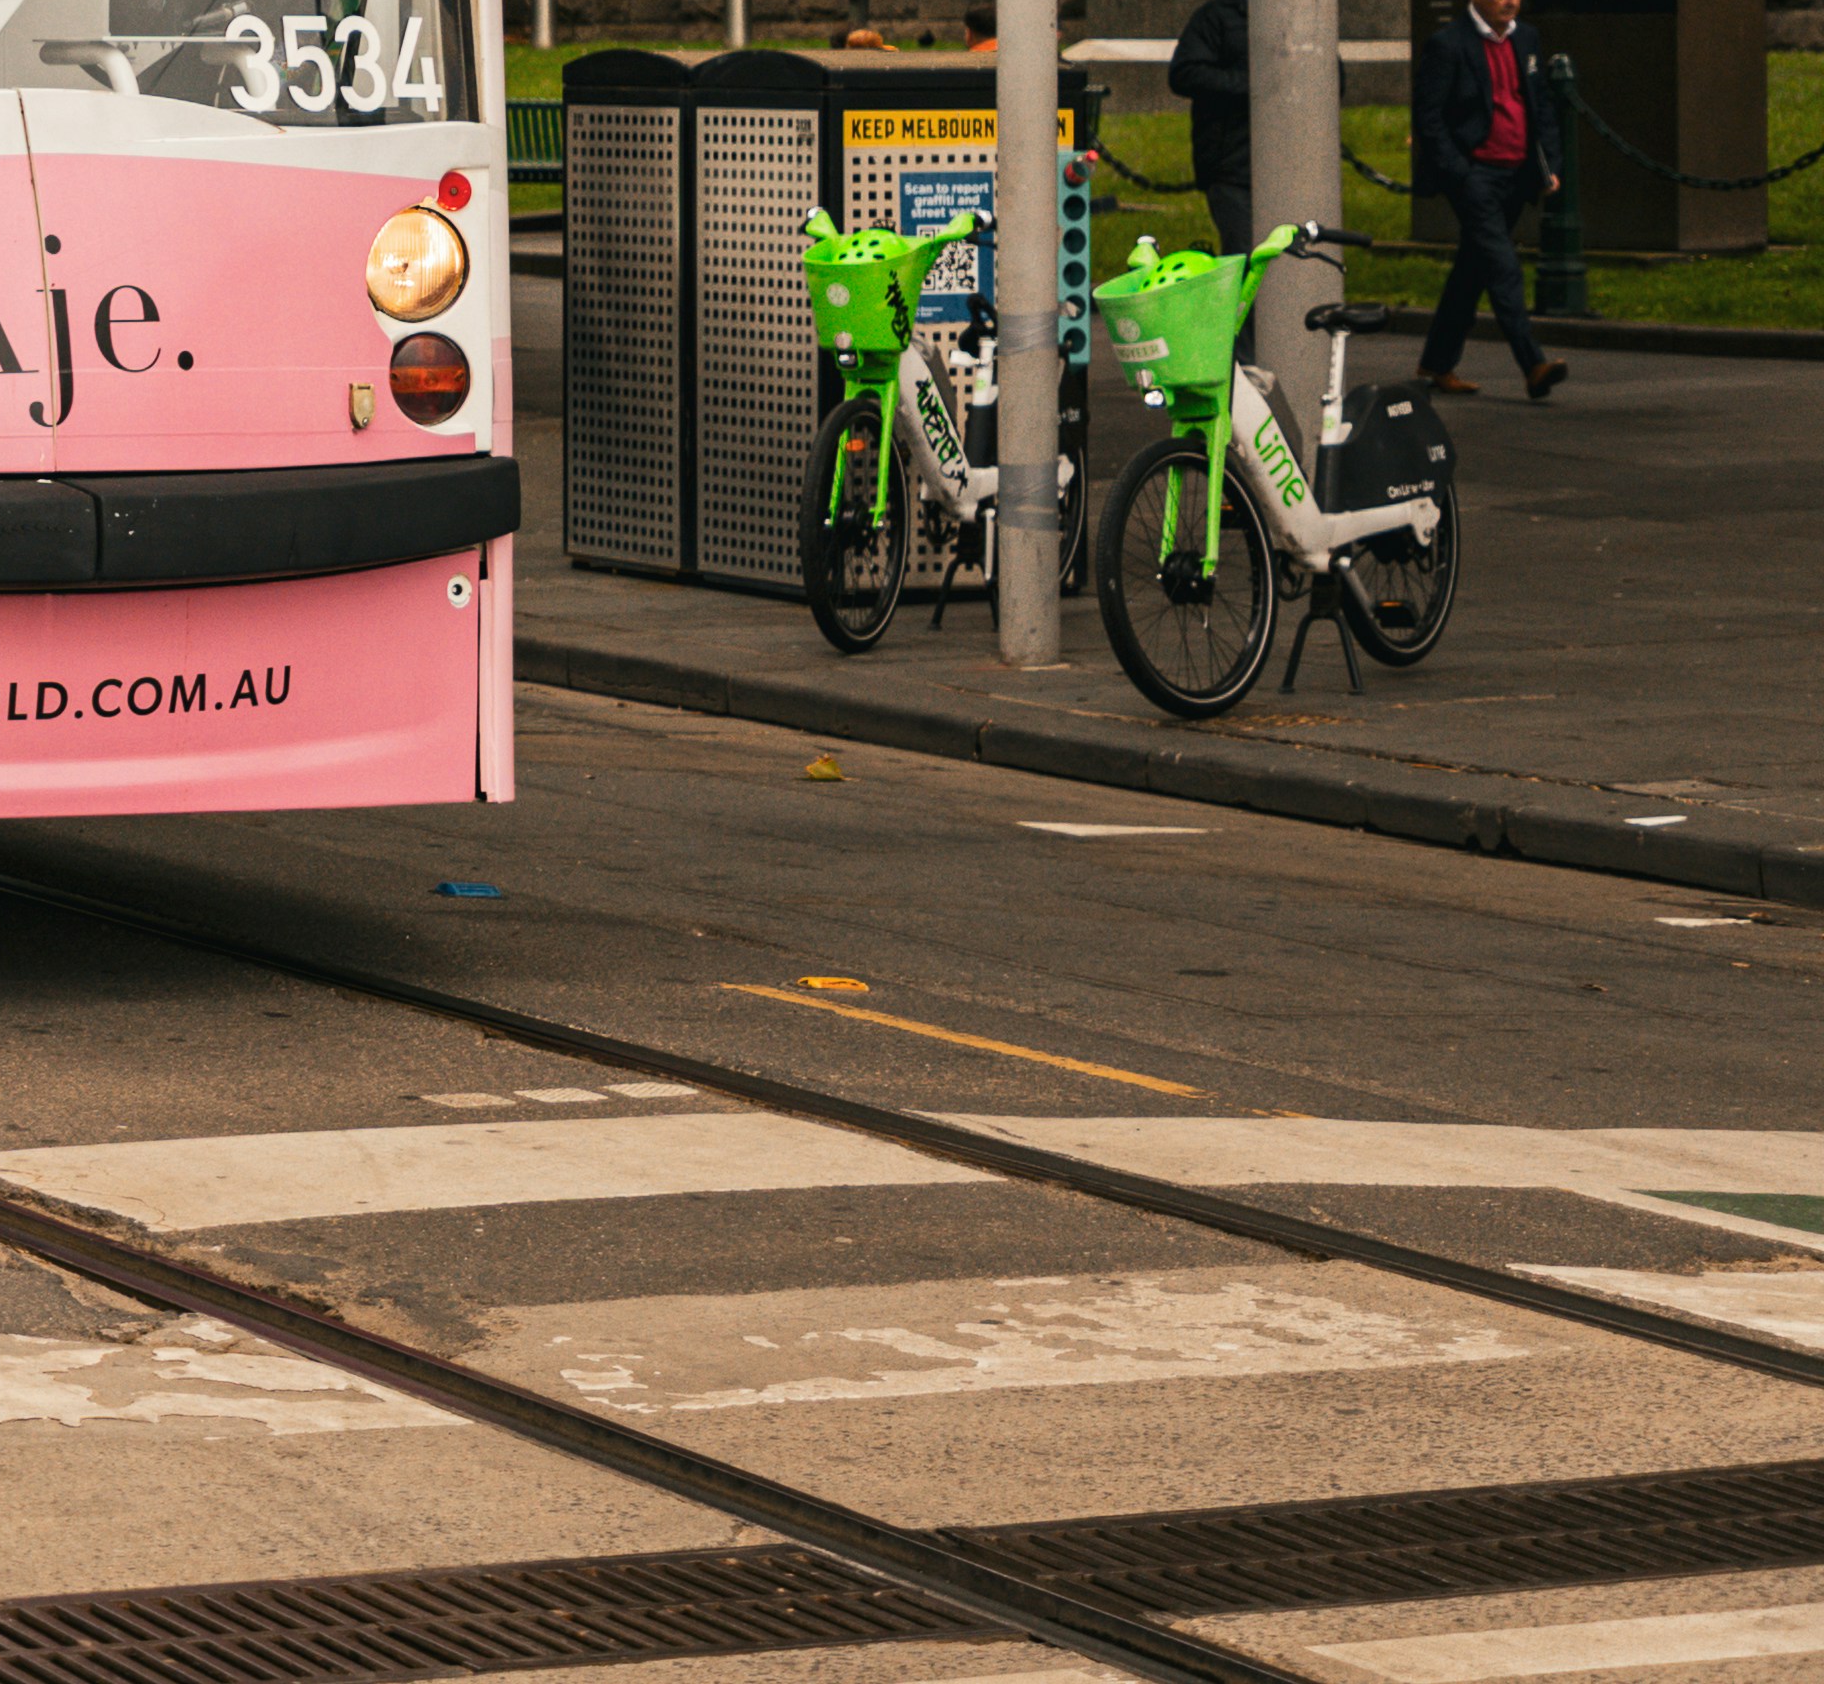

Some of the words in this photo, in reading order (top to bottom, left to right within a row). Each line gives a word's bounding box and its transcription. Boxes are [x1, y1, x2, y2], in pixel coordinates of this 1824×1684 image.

[225, 14, 444, 113] 3534
[852, 118, 895, 140] KEEP
[902, 118, 995, 140] MELBOURN
[904, 182, 934, 196] Scan
[935, 182, 950, 195] to
[952, 182, 989, 197] report
[913, 194, 955, 208] graffiti
[957, 193, 981, 206] and
[911, 207, 946, 219] street
[1254, 414, 1306, 508] Lime
